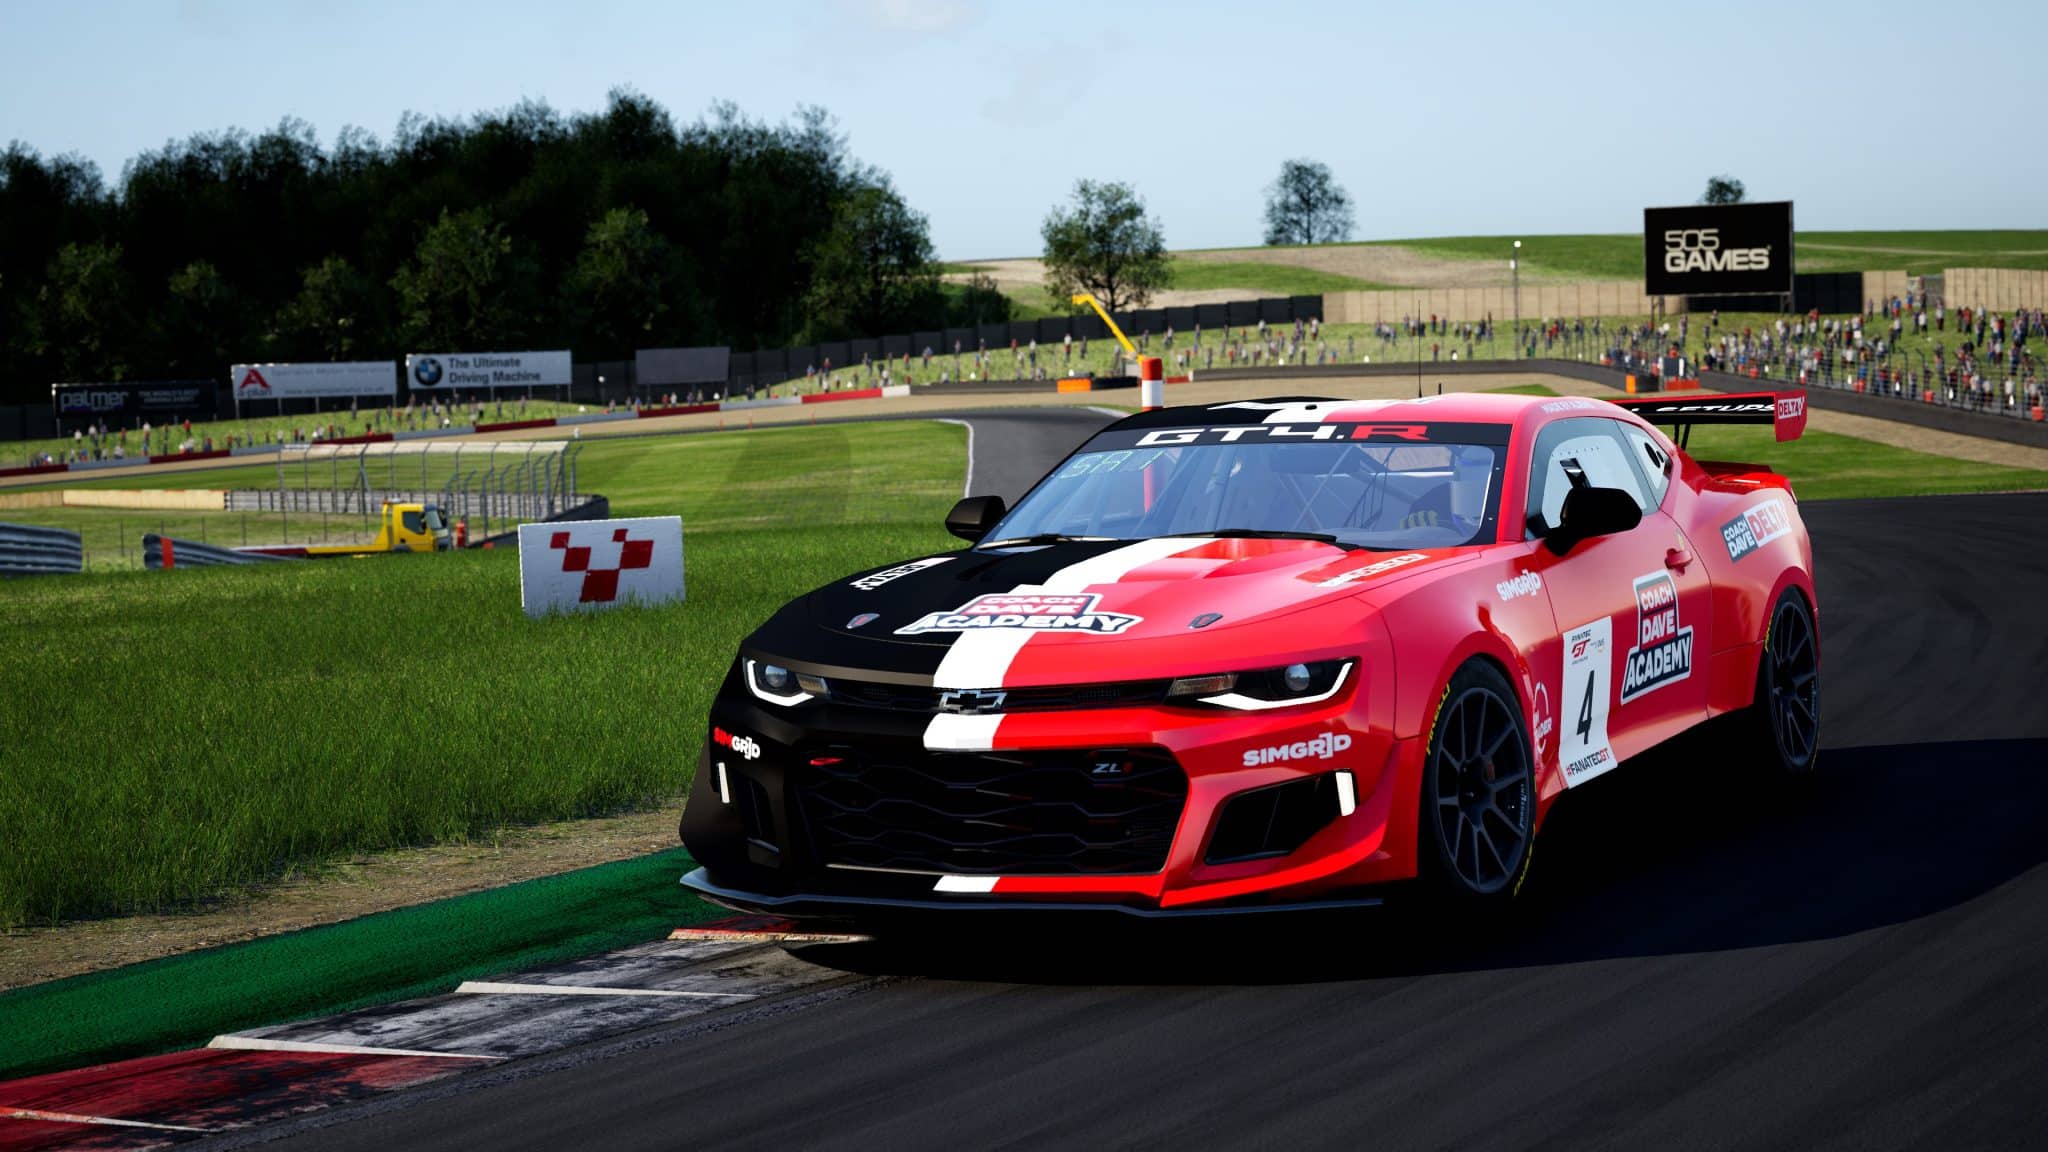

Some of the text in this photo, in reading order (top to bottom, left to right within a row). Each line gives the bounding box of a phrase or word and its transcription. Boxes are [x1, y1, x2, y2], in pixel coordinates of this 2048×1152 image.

[1664, 228, 1720, 251] 505
[1664, 248, 1770, 272] GAMES
[448, 356, 521, 369] The Ultimate
[449, 370, 541, 384] Driving Machine
[1777, 400, 1801, 417] DELTA
[1134, 424, 1432, 447] GT4.R
[1723, 518, 1749, 542] COACH
[1746, 504, 1789, 542] DELTA
[1727, 532, 1756, 559] DAVE
[981, 595, 1087, 604] COACH
[1640, 583, 1674, 611] COACH
[966, 604, 1081, 614] DAVE
[916, 613, 1133, 631] ACADEMY
[1641, 608, 1676, 644] DAVE
[1624, 634, 1691, 692] ACADEMY
[1576, 670, 1595, 745] 4
